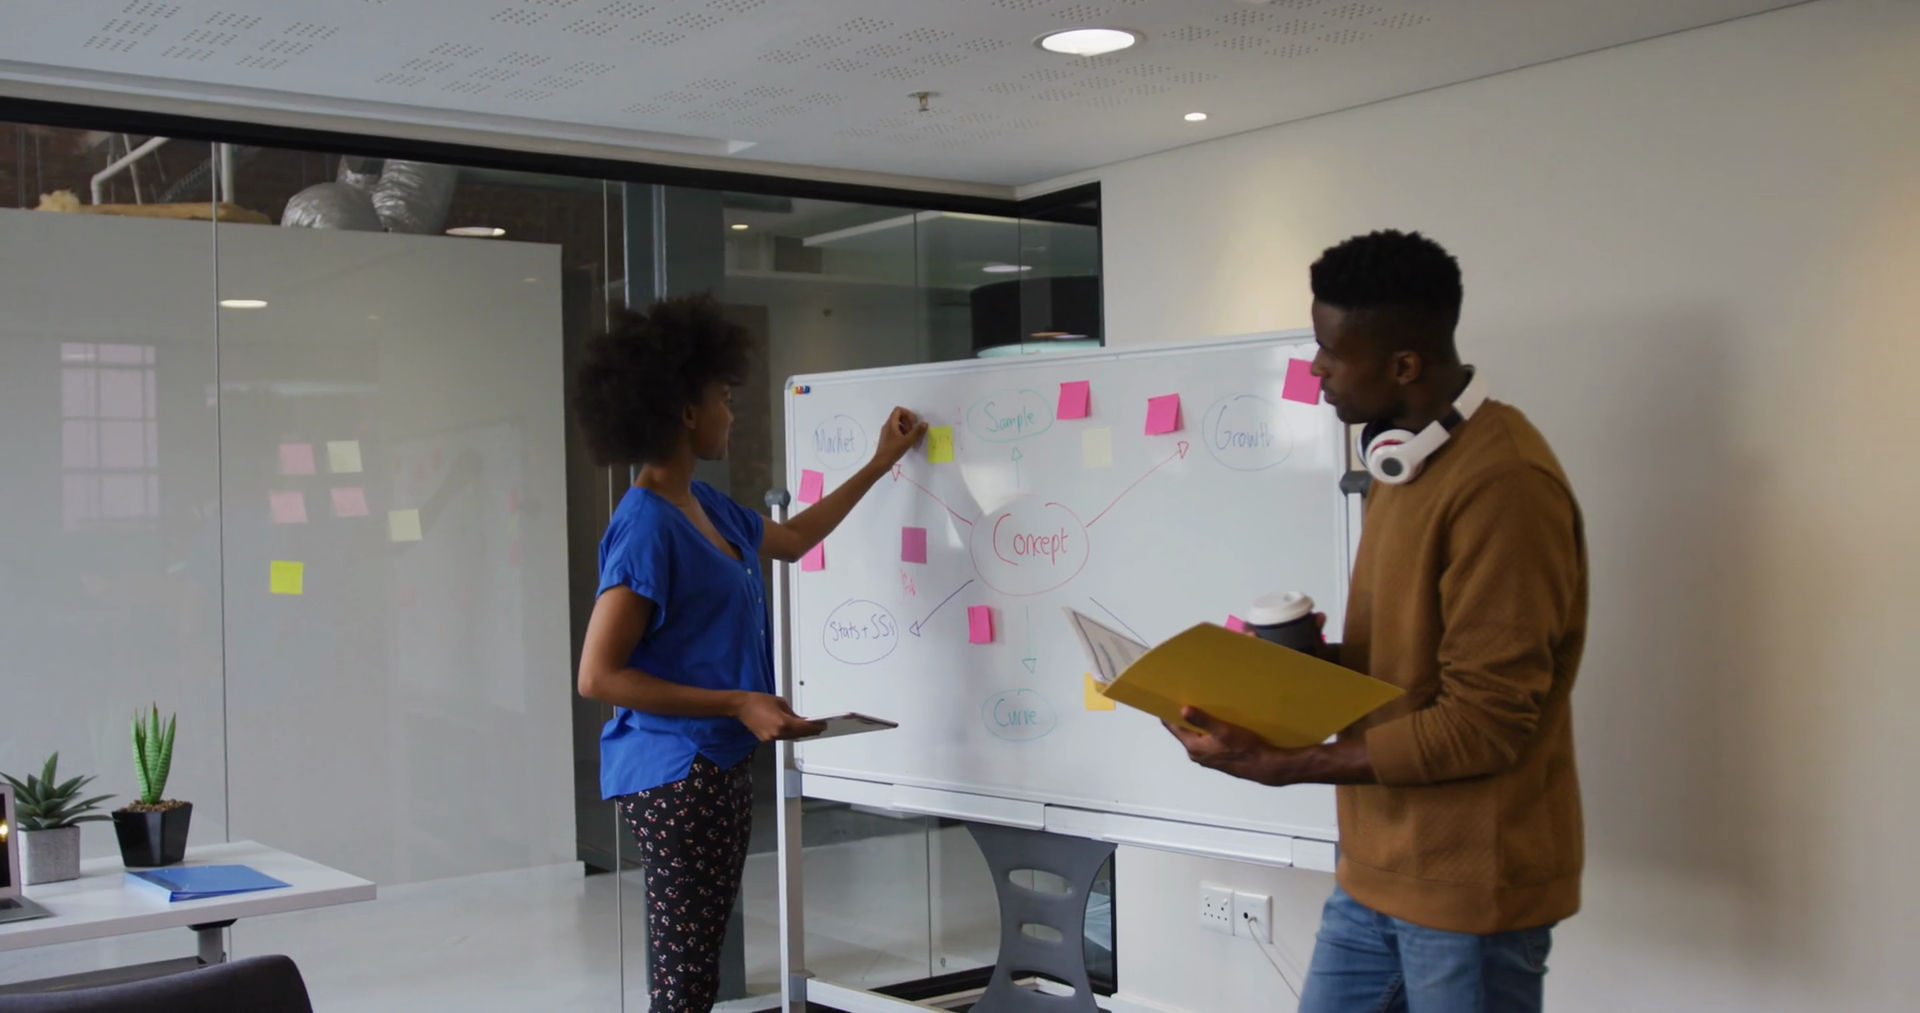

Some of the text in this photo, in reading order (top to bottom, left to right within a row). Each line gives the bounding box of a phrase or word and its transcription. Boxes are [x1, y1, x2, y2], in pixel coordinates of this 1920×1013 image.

[983, 401, 1036, 433] Sample
[1214, 404, 1273, 450] Growth
[814, 427, 855, 453] Market
[992, 512, 1069, 566] Concept
[829, 620, 860, 642] Stats
[861, 625, 868, 639] +
[993, 697, 1038, 727] Curve
